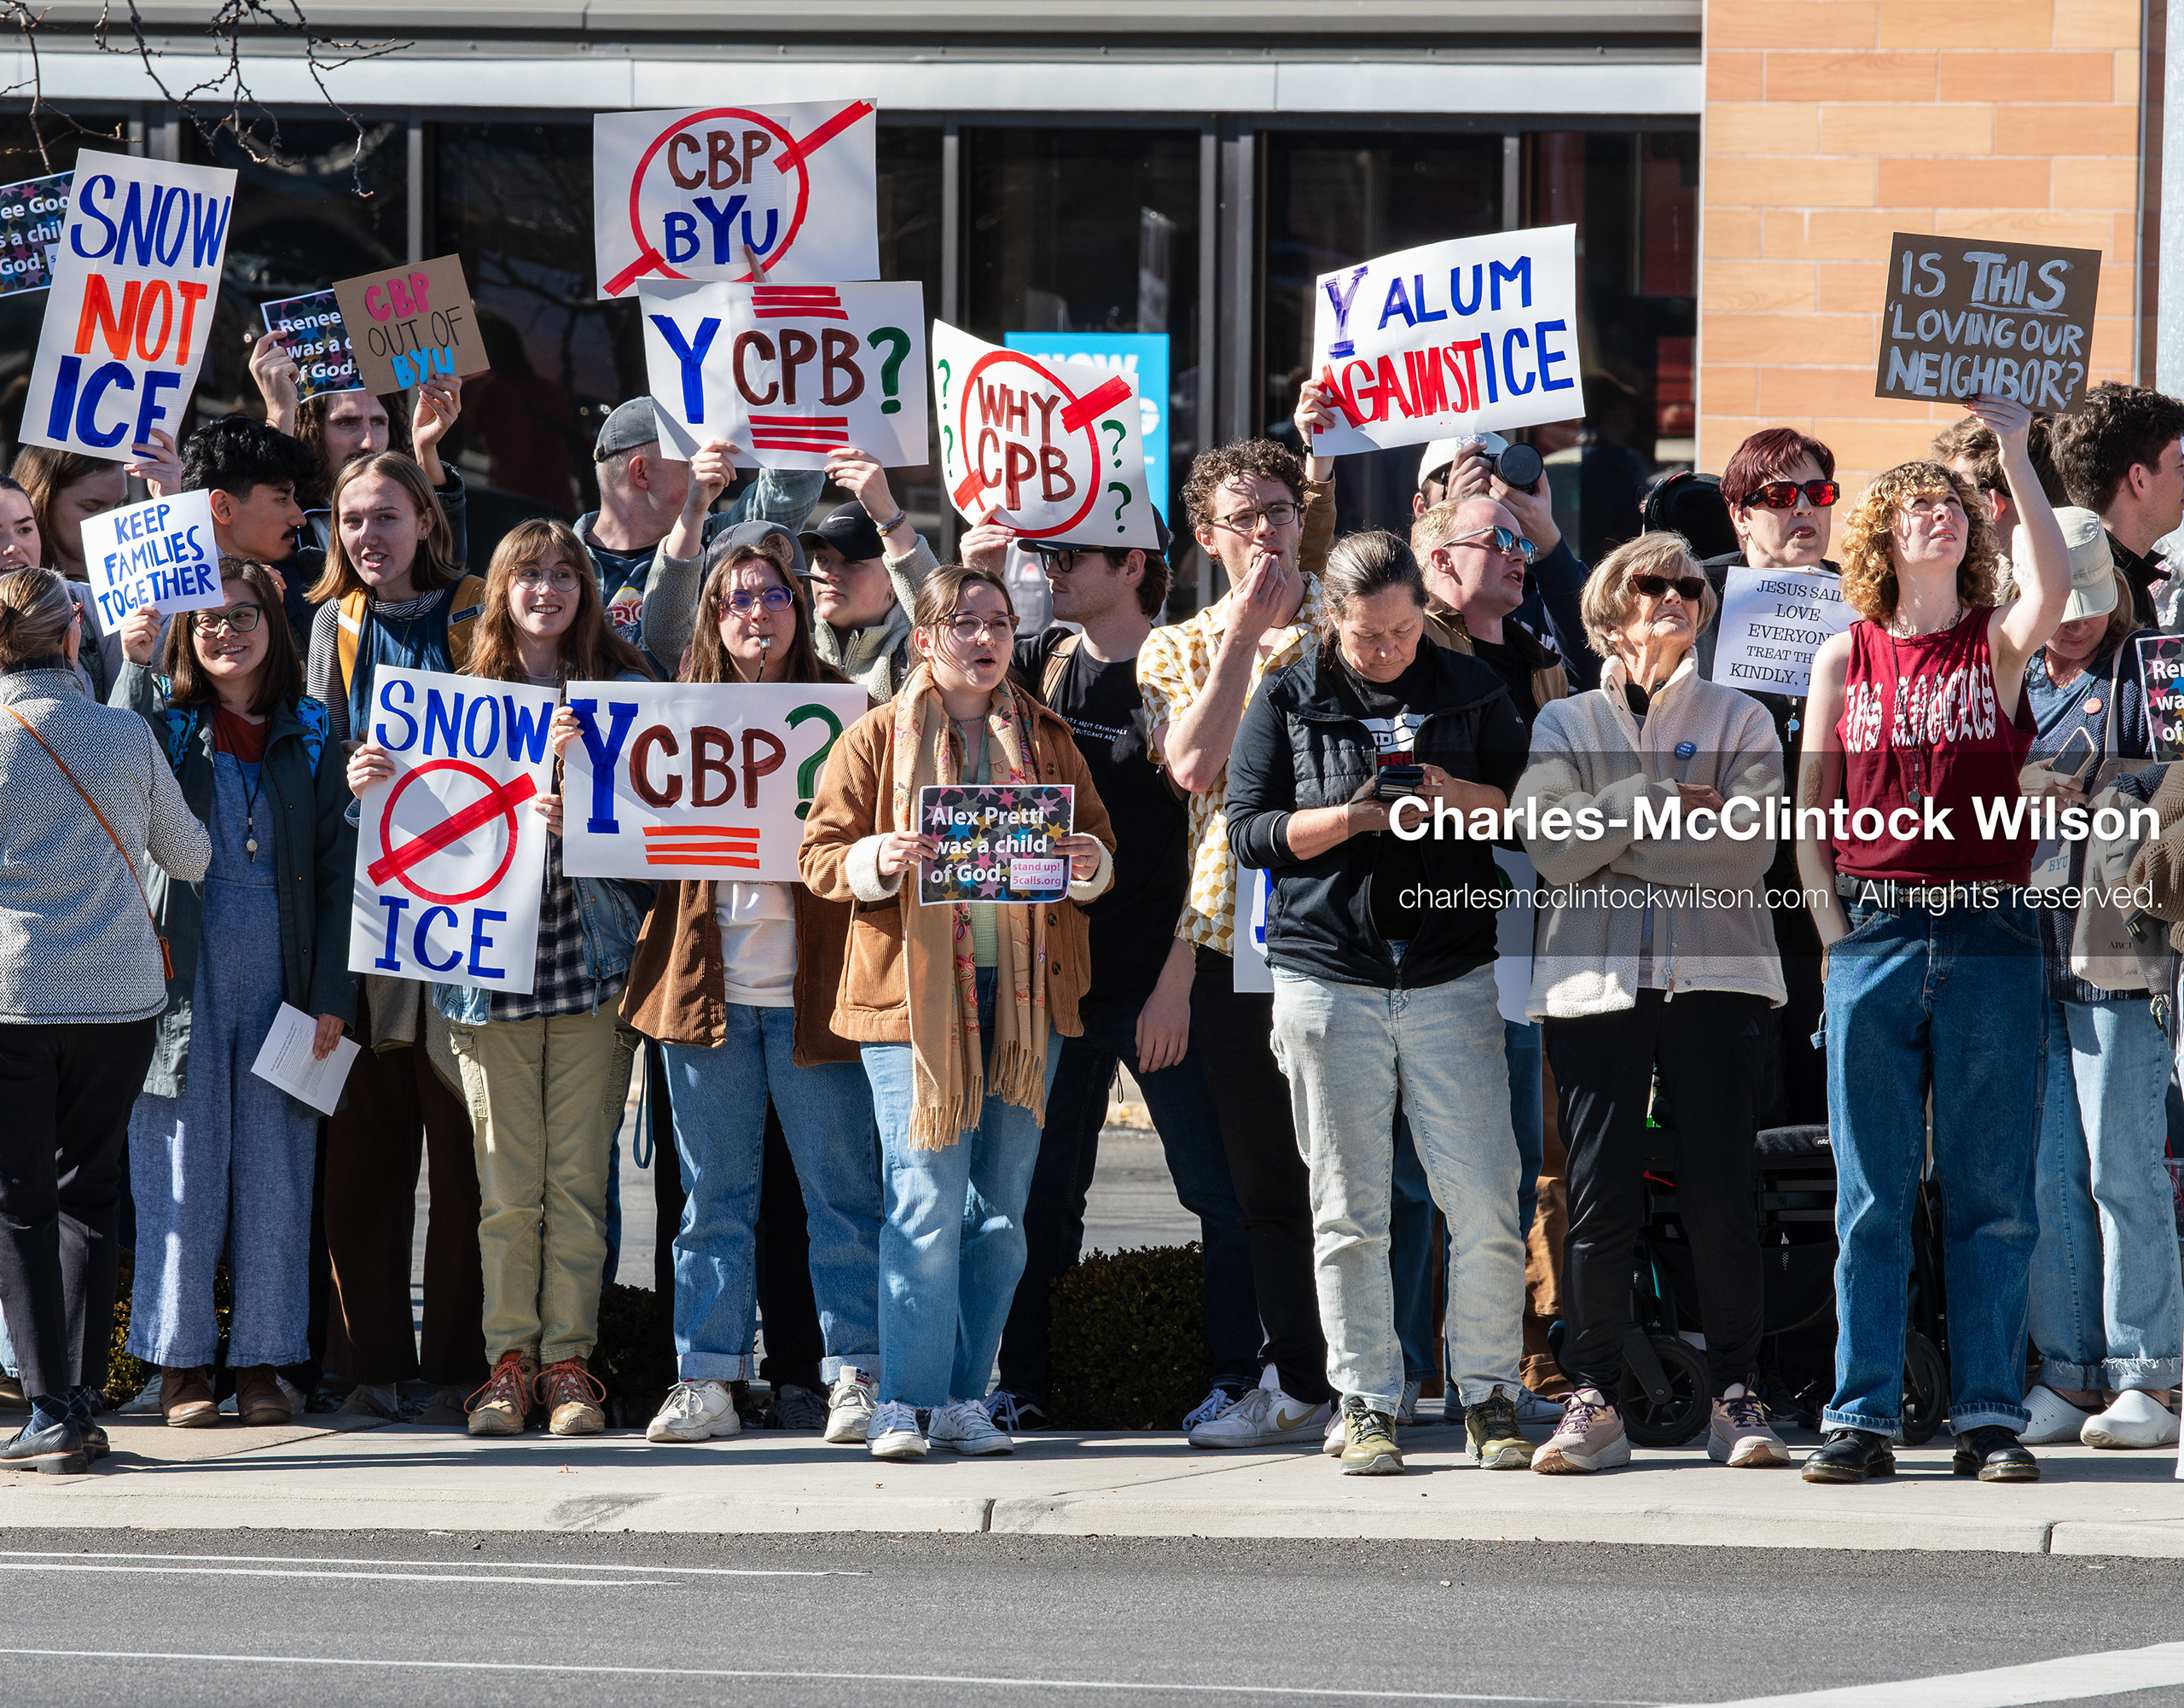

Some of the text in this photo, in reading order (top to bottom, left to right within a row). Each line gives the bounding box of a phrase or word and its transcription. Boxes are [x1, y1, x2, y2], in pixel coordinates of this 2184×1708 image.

[666, 130, 772, 190] CBP
[71, 174, 231, 267] SNOW
[663, 195, 779, 264] BYU
[365, 272, 430, 322] CBP
[1902, 250, 2073, 311] IS THIS
[73, 273, 206, 365] NOT
[279, 311, 341, 334] Renee
[368, 305, 462, 357] OUT OF
[1321, 255, 1532, 359] Y ALUM
[286, 342, 324, 359] was
[1481, 319, 1574, 404] ICE
[2020, 319, 2084, 357] OUR
[311, 358, 357, 379] God.
[392, 346, 454, 389] BYU
[648, 313, 722, 425] Y
[47, 355, 181, 459] ICE
[977, 376, 1060, 447] WHY
[1101, 419, 1126, 468] ?
[978, 427, 1076, 511] CPB
[113, 503, 170, 545] KEEP
[1107, 481, 1131, 533] ?
[103, 525, 205, 587] FAMILIES
[98, 563, 216, 626] TOGETHER
[1757, 579, 1808, 598] JESUS
[1774, 603, 1821, 622] LOVE
[1746, 645, 1815, 665] TREAT TH
[1747, 623, 1834, 646] EVERYON
[1729, 662, 1798, 687] KINDLY,
[376, 679, 554, 765] SNOW
[1095, 724, 1127, 735] CRIMINALS
[566, 699, 638, 834] Y
[931, 805, 1044, 826] Alex Pretti
[977, 840, 990, 853] a
[995, 834, 1047, 853] child
[1013, 862, 1060, 874] stand up!
[2048, 855, 2068, 872] BYU
[930, 863, 1007, 884] of God.
[1013, 875, 1061, 888] 5calls.org
[375, 895, 508, 979] ICE
